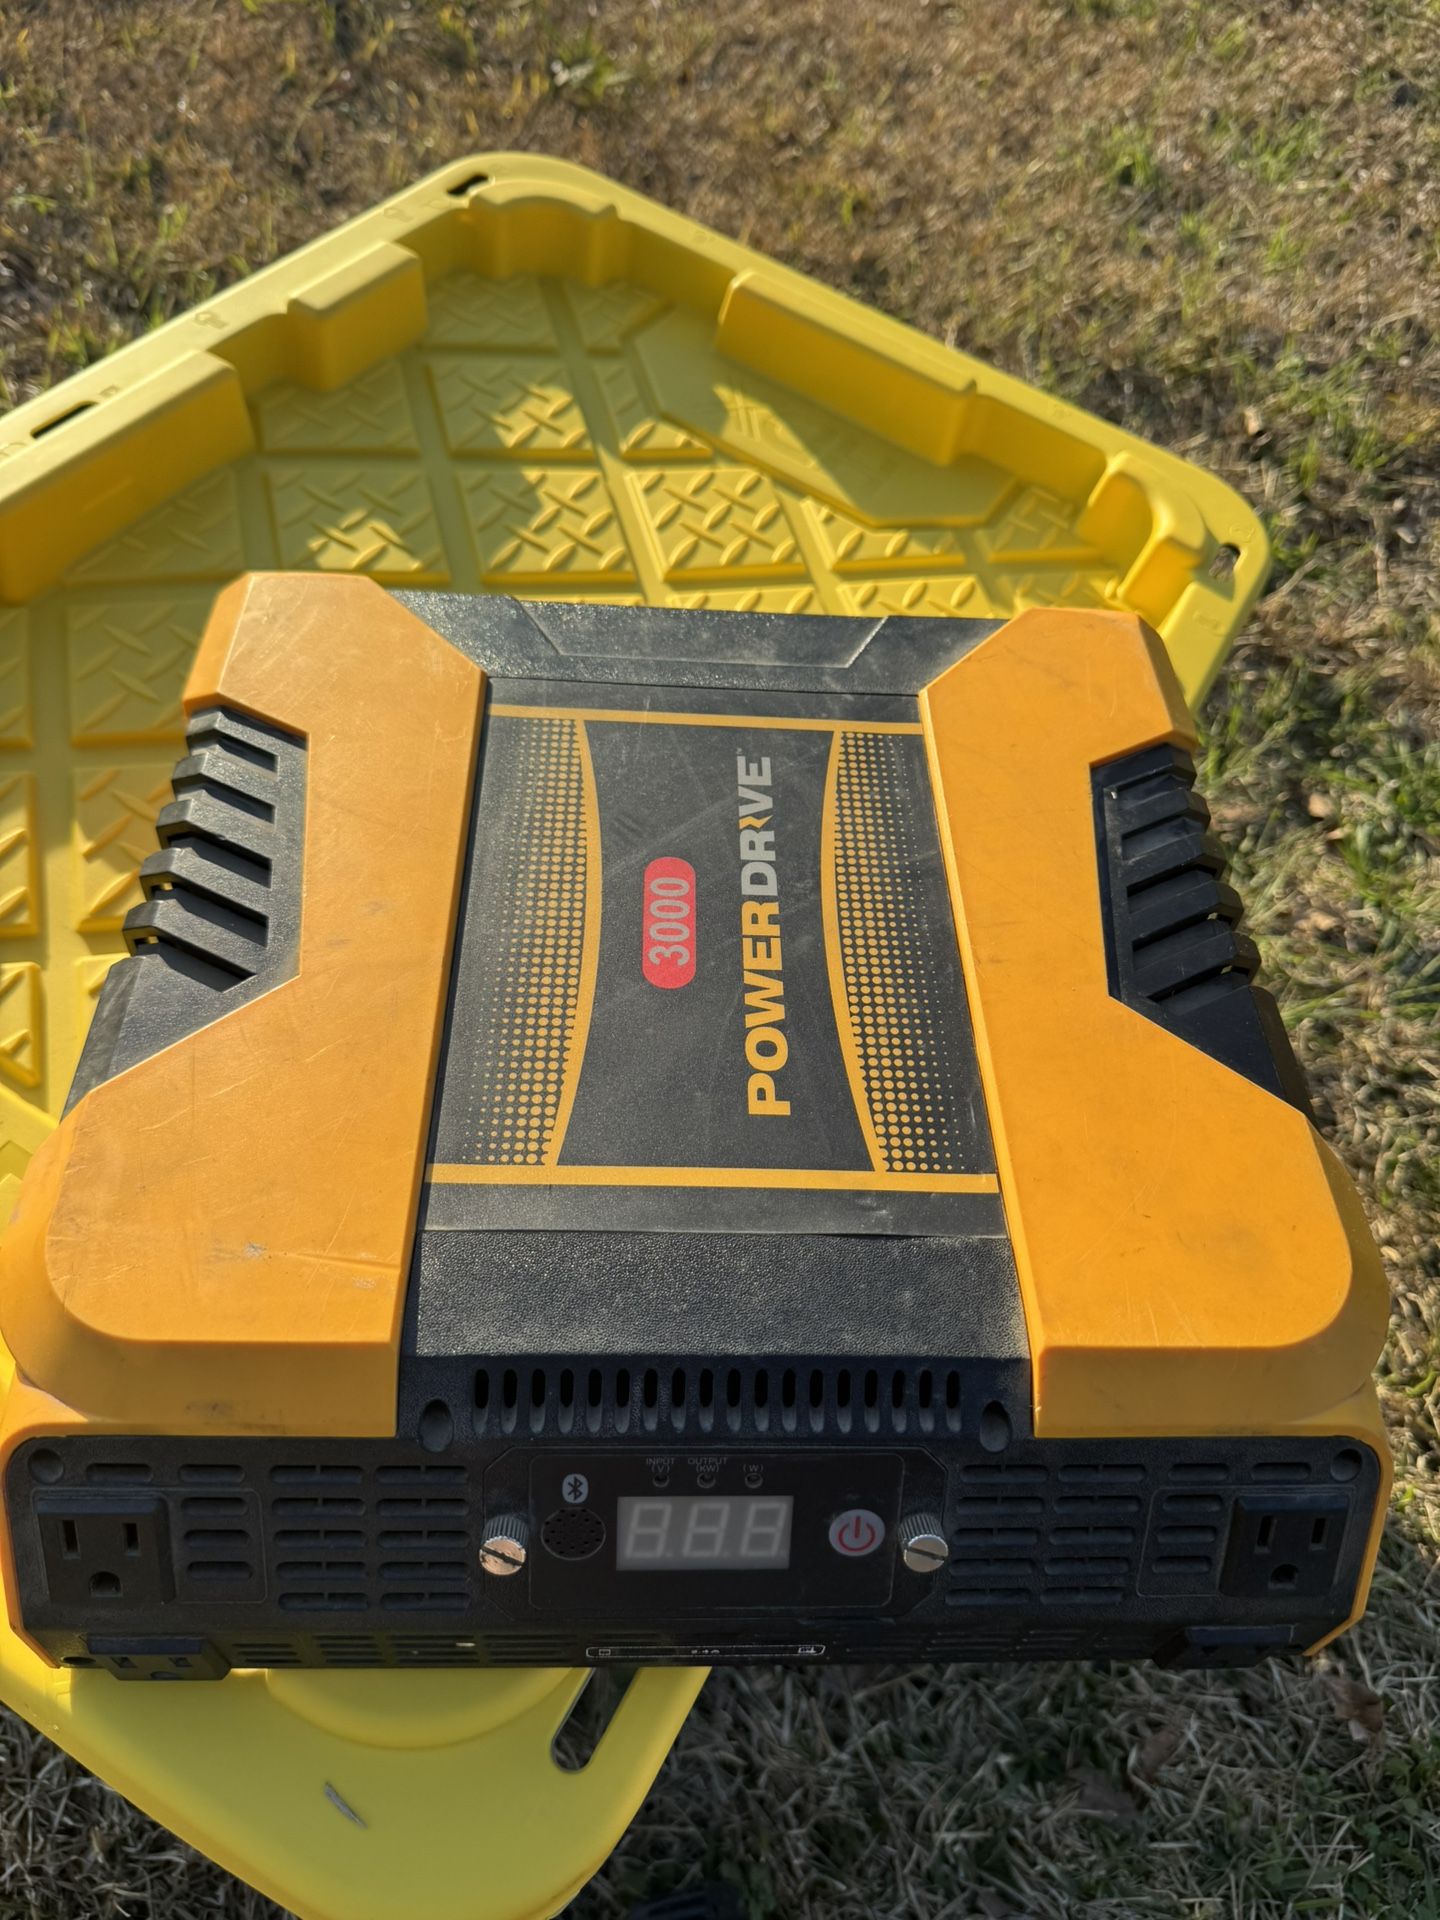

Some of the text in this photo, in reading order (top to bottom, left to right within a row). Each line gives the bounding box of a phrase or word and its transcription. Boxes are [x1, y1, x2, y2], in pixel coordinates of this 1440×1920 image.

[649, 876, 690, 967] 3000
[645, 1456, 675, 1465] INPUT
[687, 1456, 728, 1465] OUTPUT
[696, 1464, 720, 1473] (KW)
